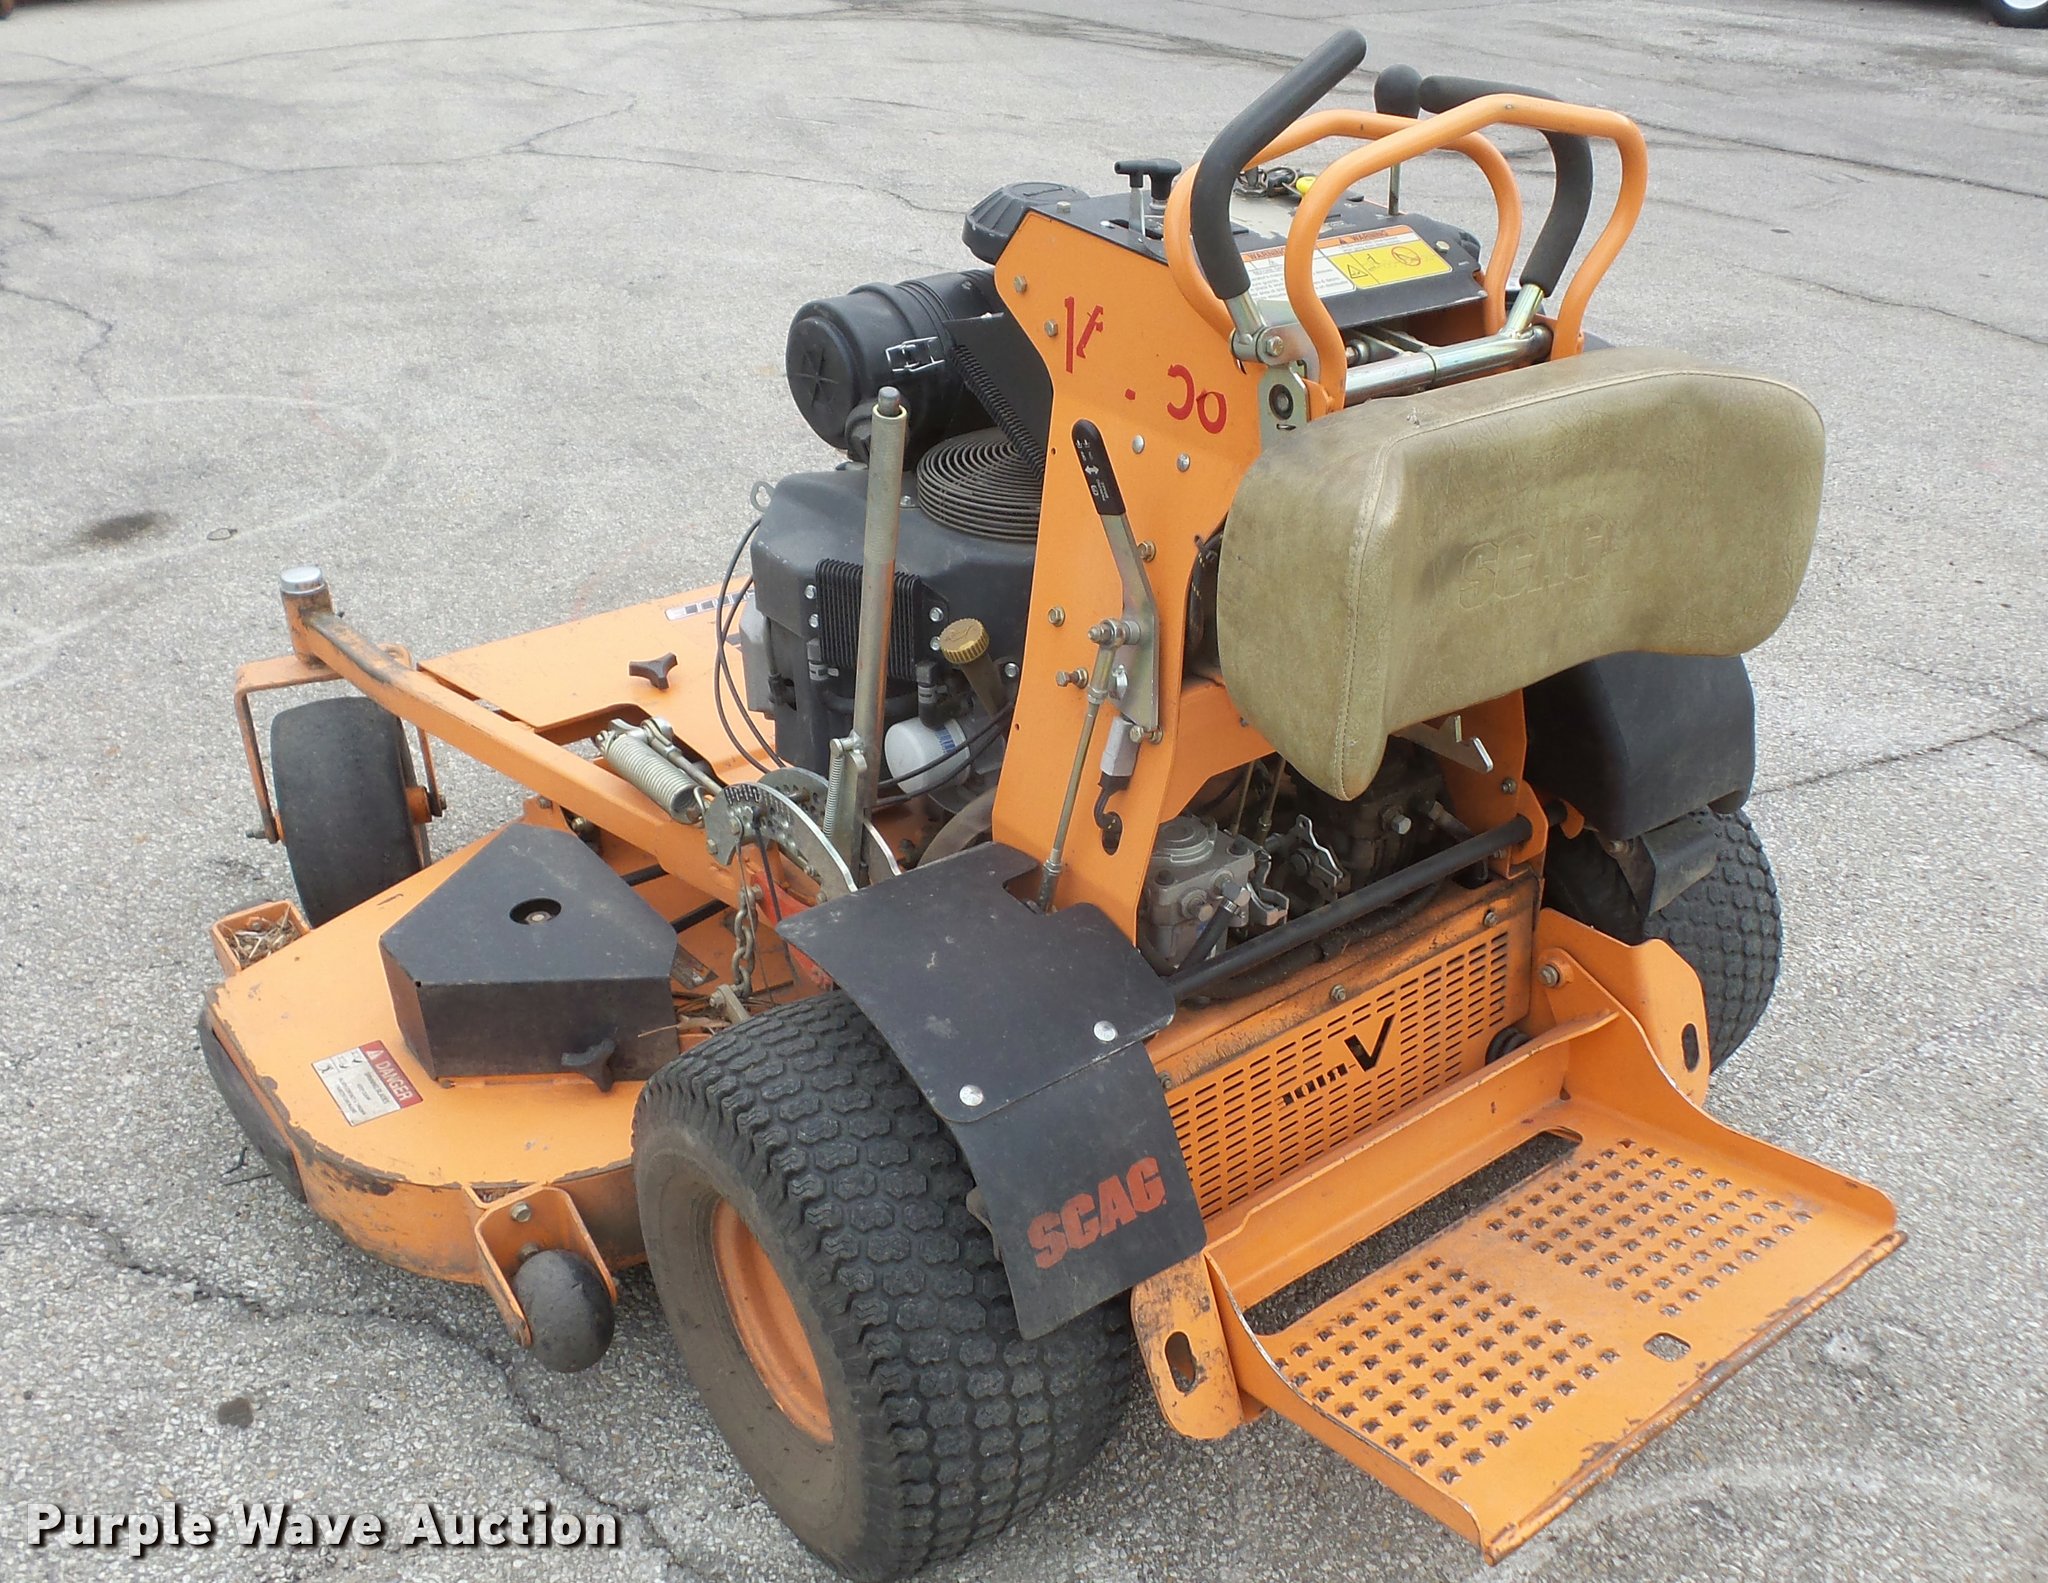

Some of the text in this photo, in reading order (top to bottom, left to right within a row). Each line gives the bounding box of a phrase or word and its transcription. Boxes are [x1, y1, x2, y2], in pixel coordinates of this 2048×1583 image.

[1352, 229, 1388, 243] WARNING
[375, 1062, 413, 1100] DANGER
[1026, 1156, 1166, 1269] SCAG
